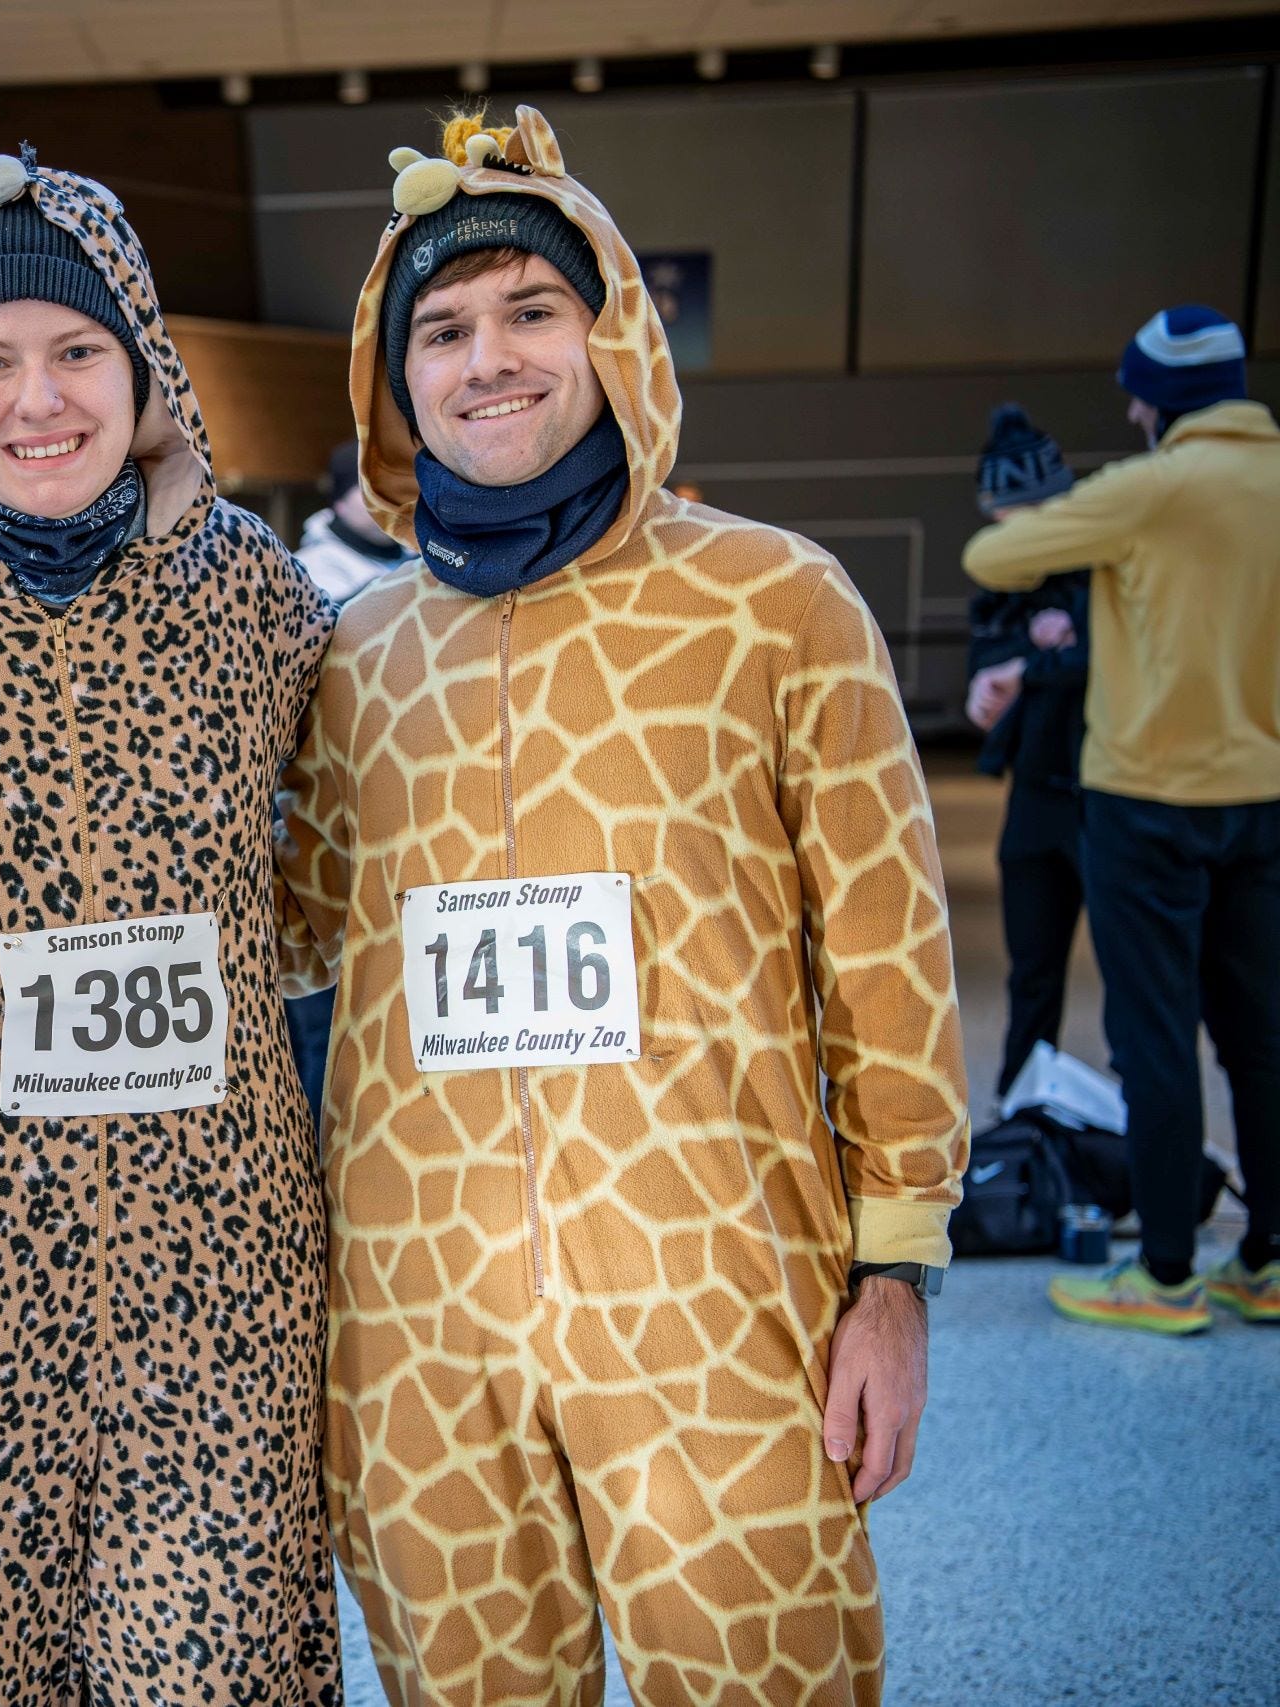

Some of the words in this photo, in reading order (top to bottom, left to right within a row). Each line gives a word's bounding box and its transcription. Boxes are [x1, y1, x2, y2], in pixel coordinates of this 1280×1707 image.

[437, 219, 518, 247] DIFFERENCE
[457, 228, 518, 243] PRINCIPLE
[436, 889, 511, 913] Samson
[516, 883, 583, 909] Stomp
[47, 931, 122, 953] Samson
[127, 924, 185, 944] Stomp
[424, 920, 611, 1018] 1416
[20, 961, 214, 1052] 1385
[421, 1031, 510, 1057] Milwaukee
[515, 1028, 586, 1055] County
[589, 1025, 627, 1048] Zoo
[12, 1072, 121, 1093] Milwaukee
[124, 1067, 186, 1090] County
[185, 1064, 212, 1084] Zoo
